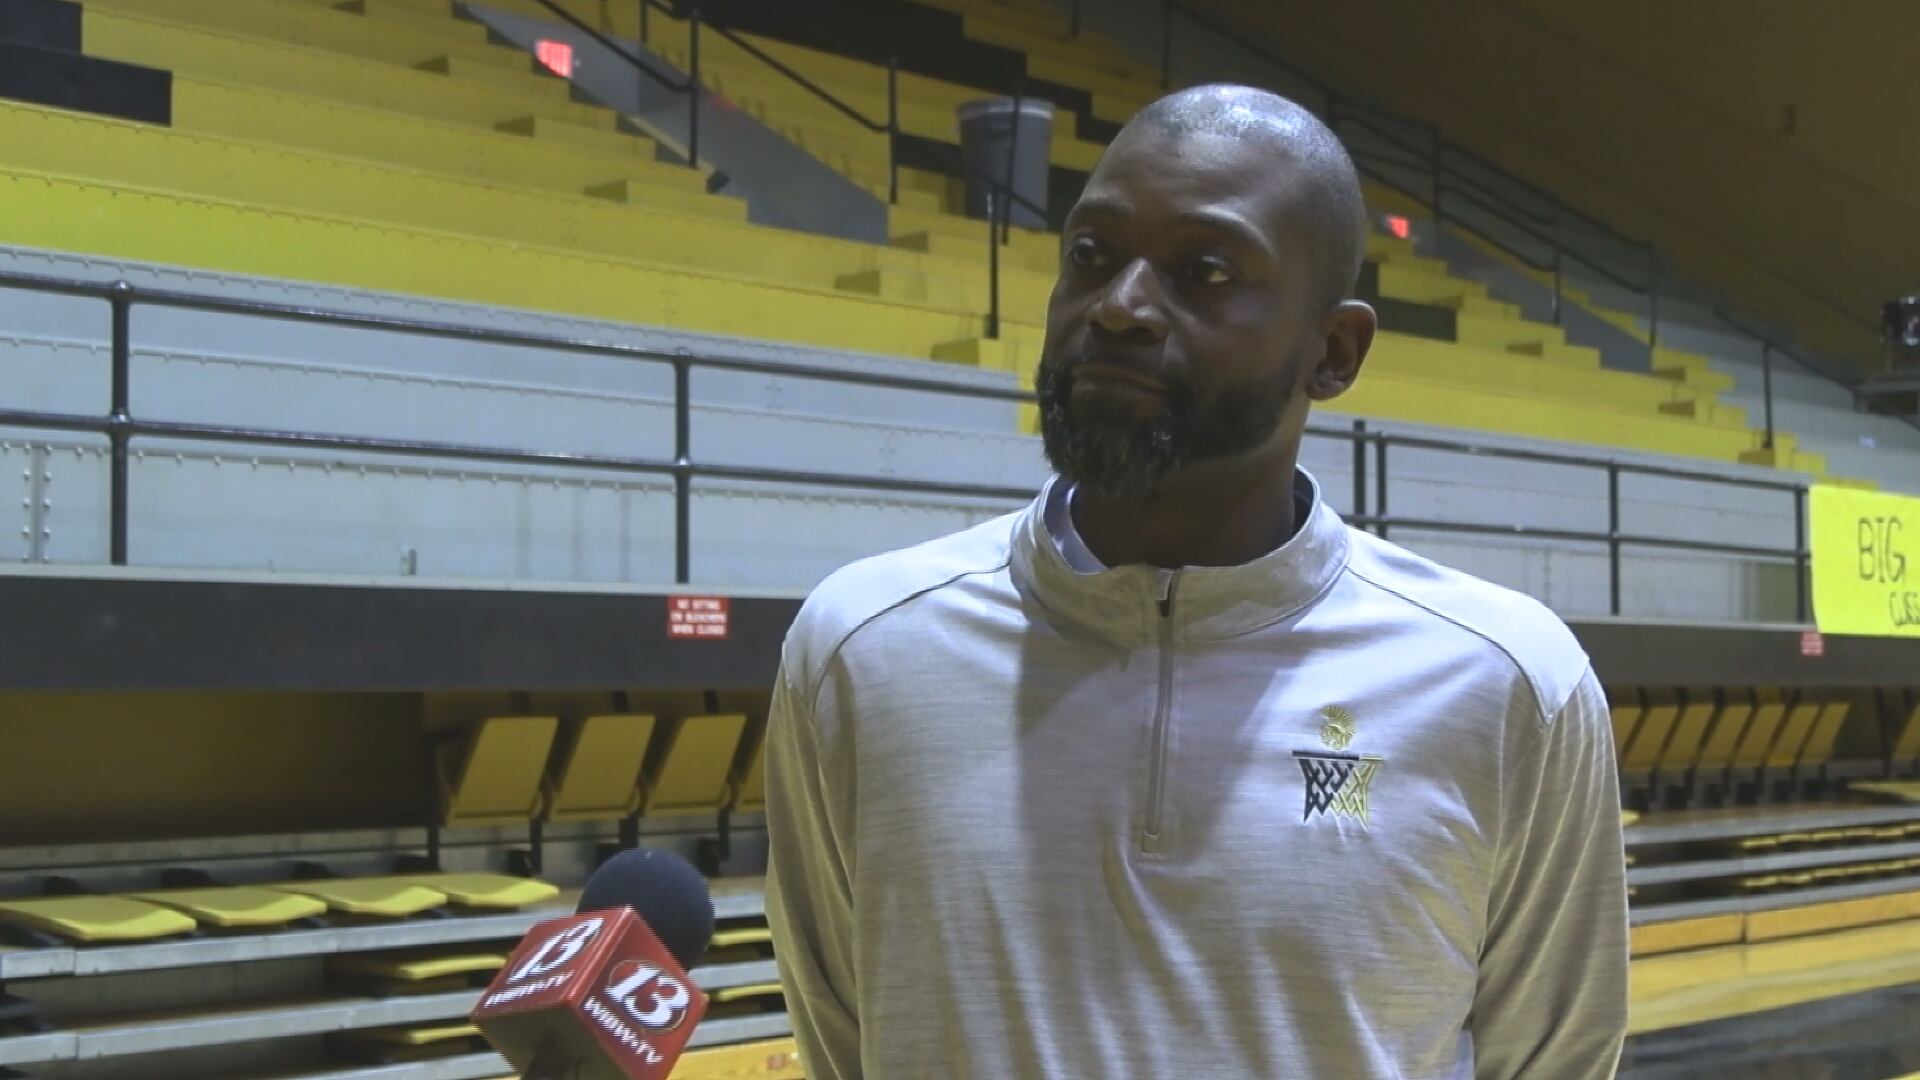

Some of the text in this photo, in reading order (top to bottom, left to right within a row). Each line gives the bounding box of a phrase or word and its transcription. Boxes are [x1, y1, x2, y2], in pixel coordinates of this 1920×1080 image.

[1858, 516, 1906, 584] BIG
[506, 917, 604, 984] 13
[604, 965, 690, 1027] 13
